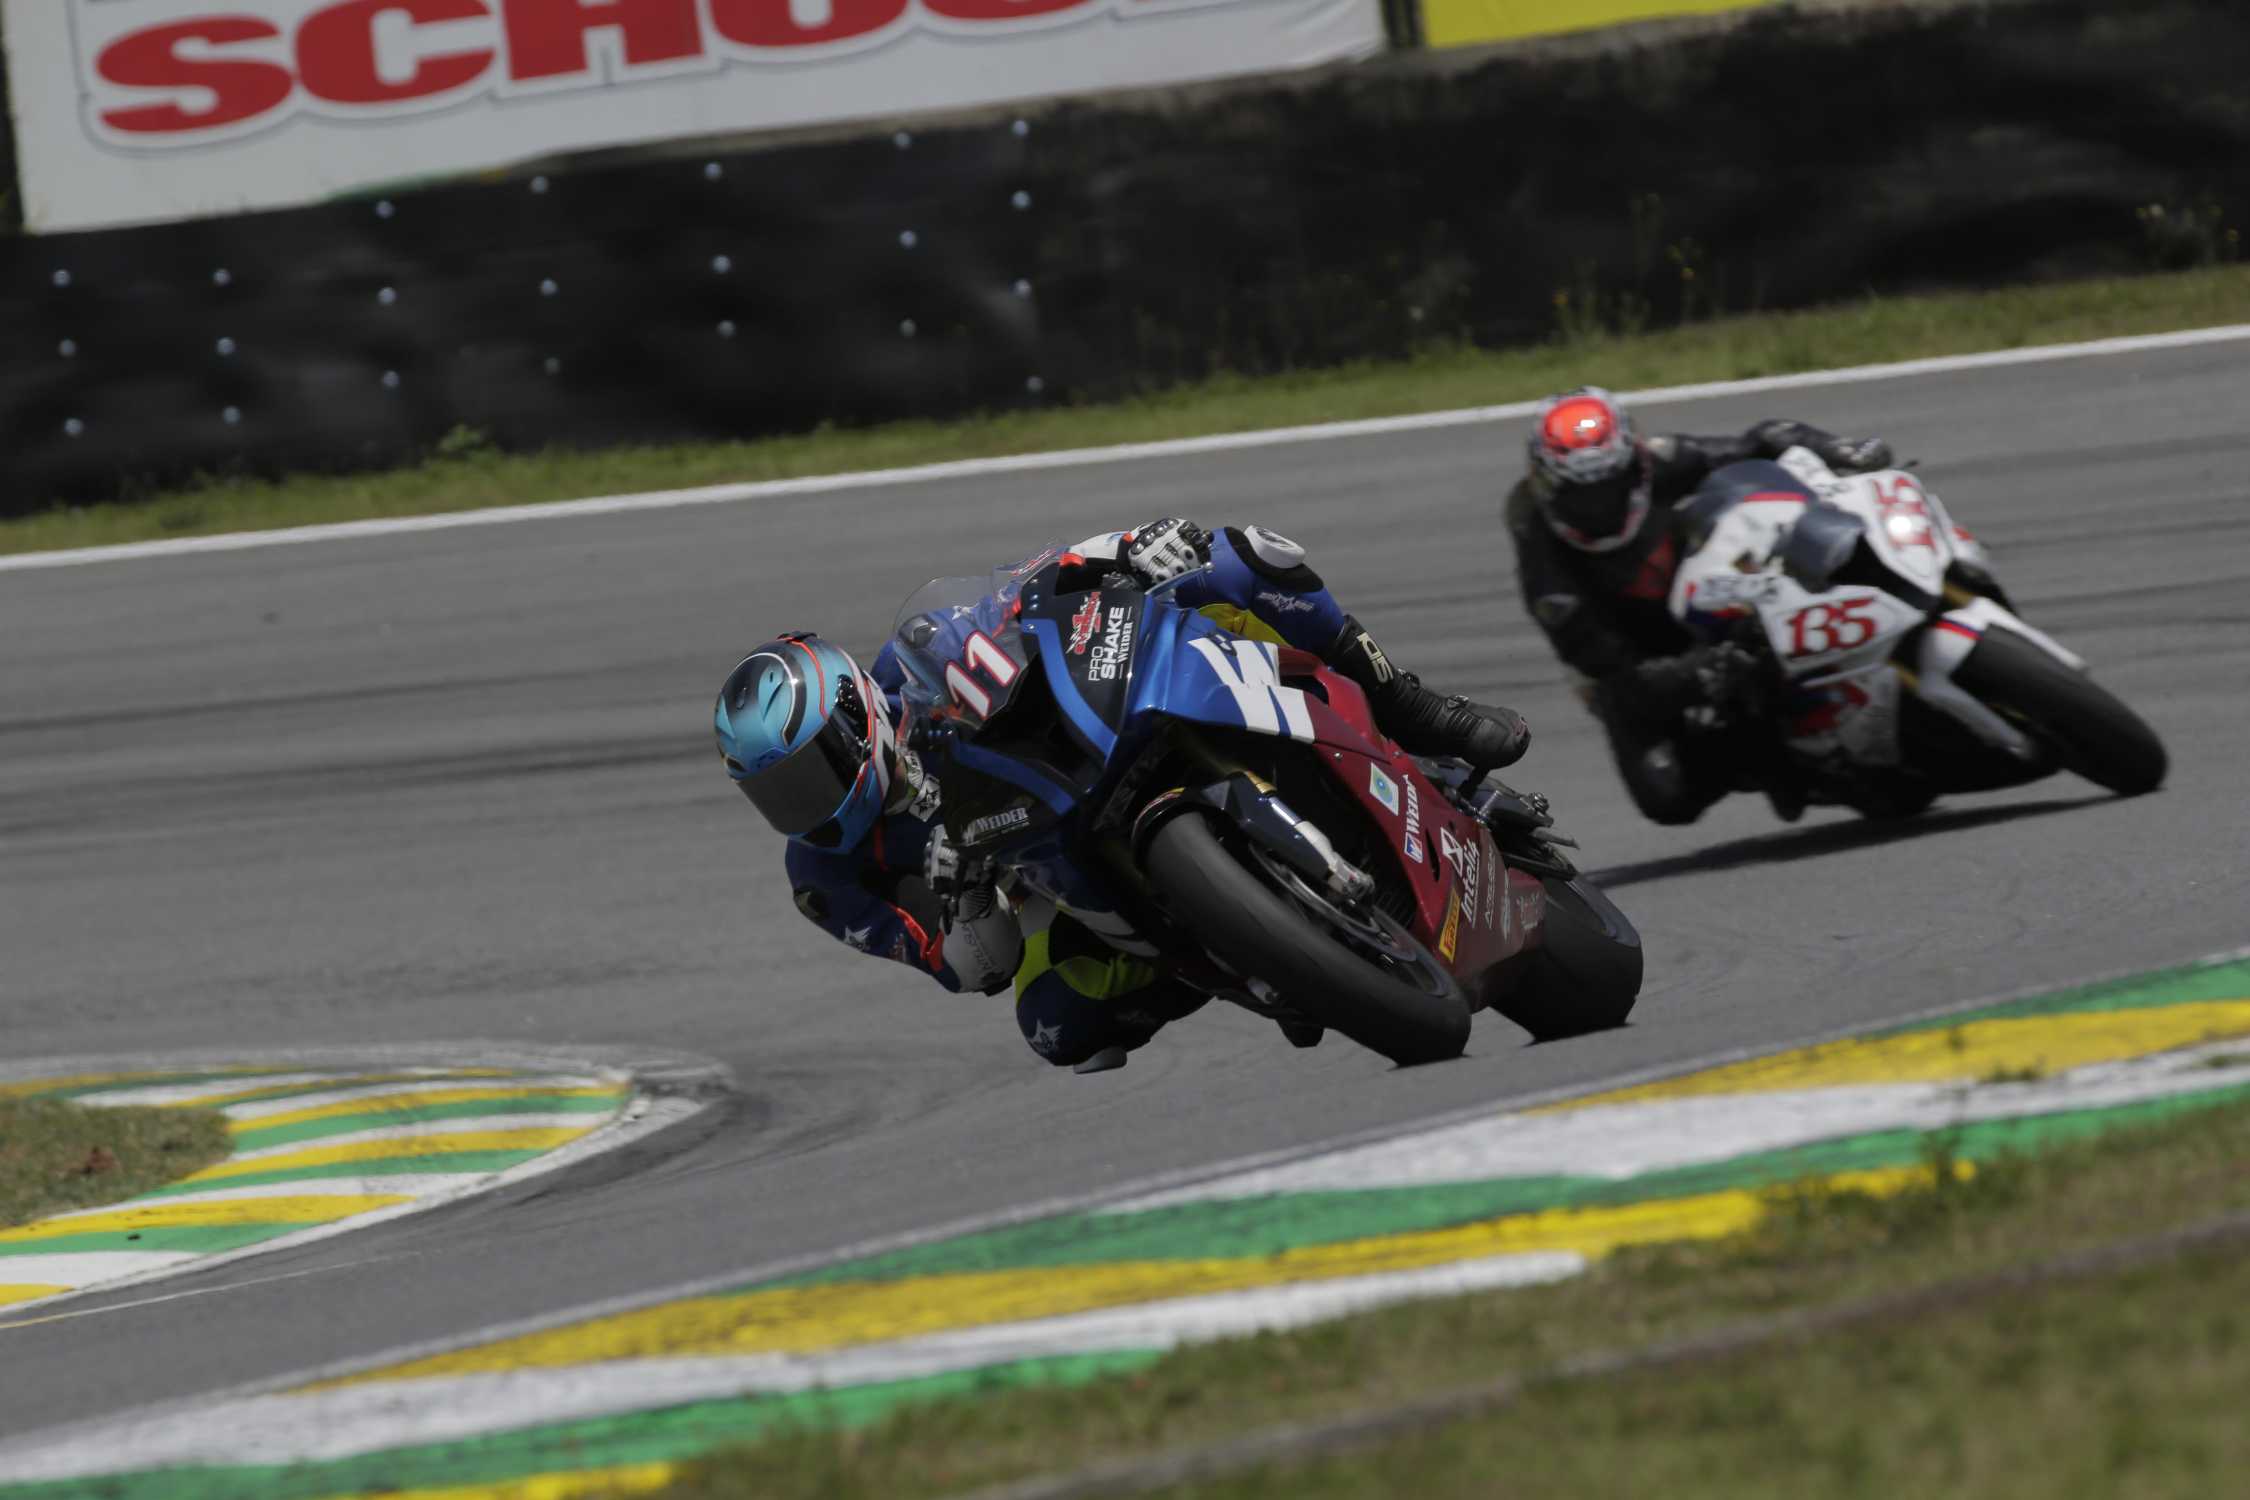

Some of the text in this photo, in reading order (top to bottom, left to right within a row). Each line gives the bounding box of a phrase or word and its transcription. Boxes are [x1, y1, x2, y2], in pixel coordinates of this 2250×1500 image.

[1088, 646, 1104, 681] PRO
[1100, 607, 1124, 680] SHAKE
[1117, 621, 1133, 663] WEIDER
[944, 629, 1020, 721] 11
